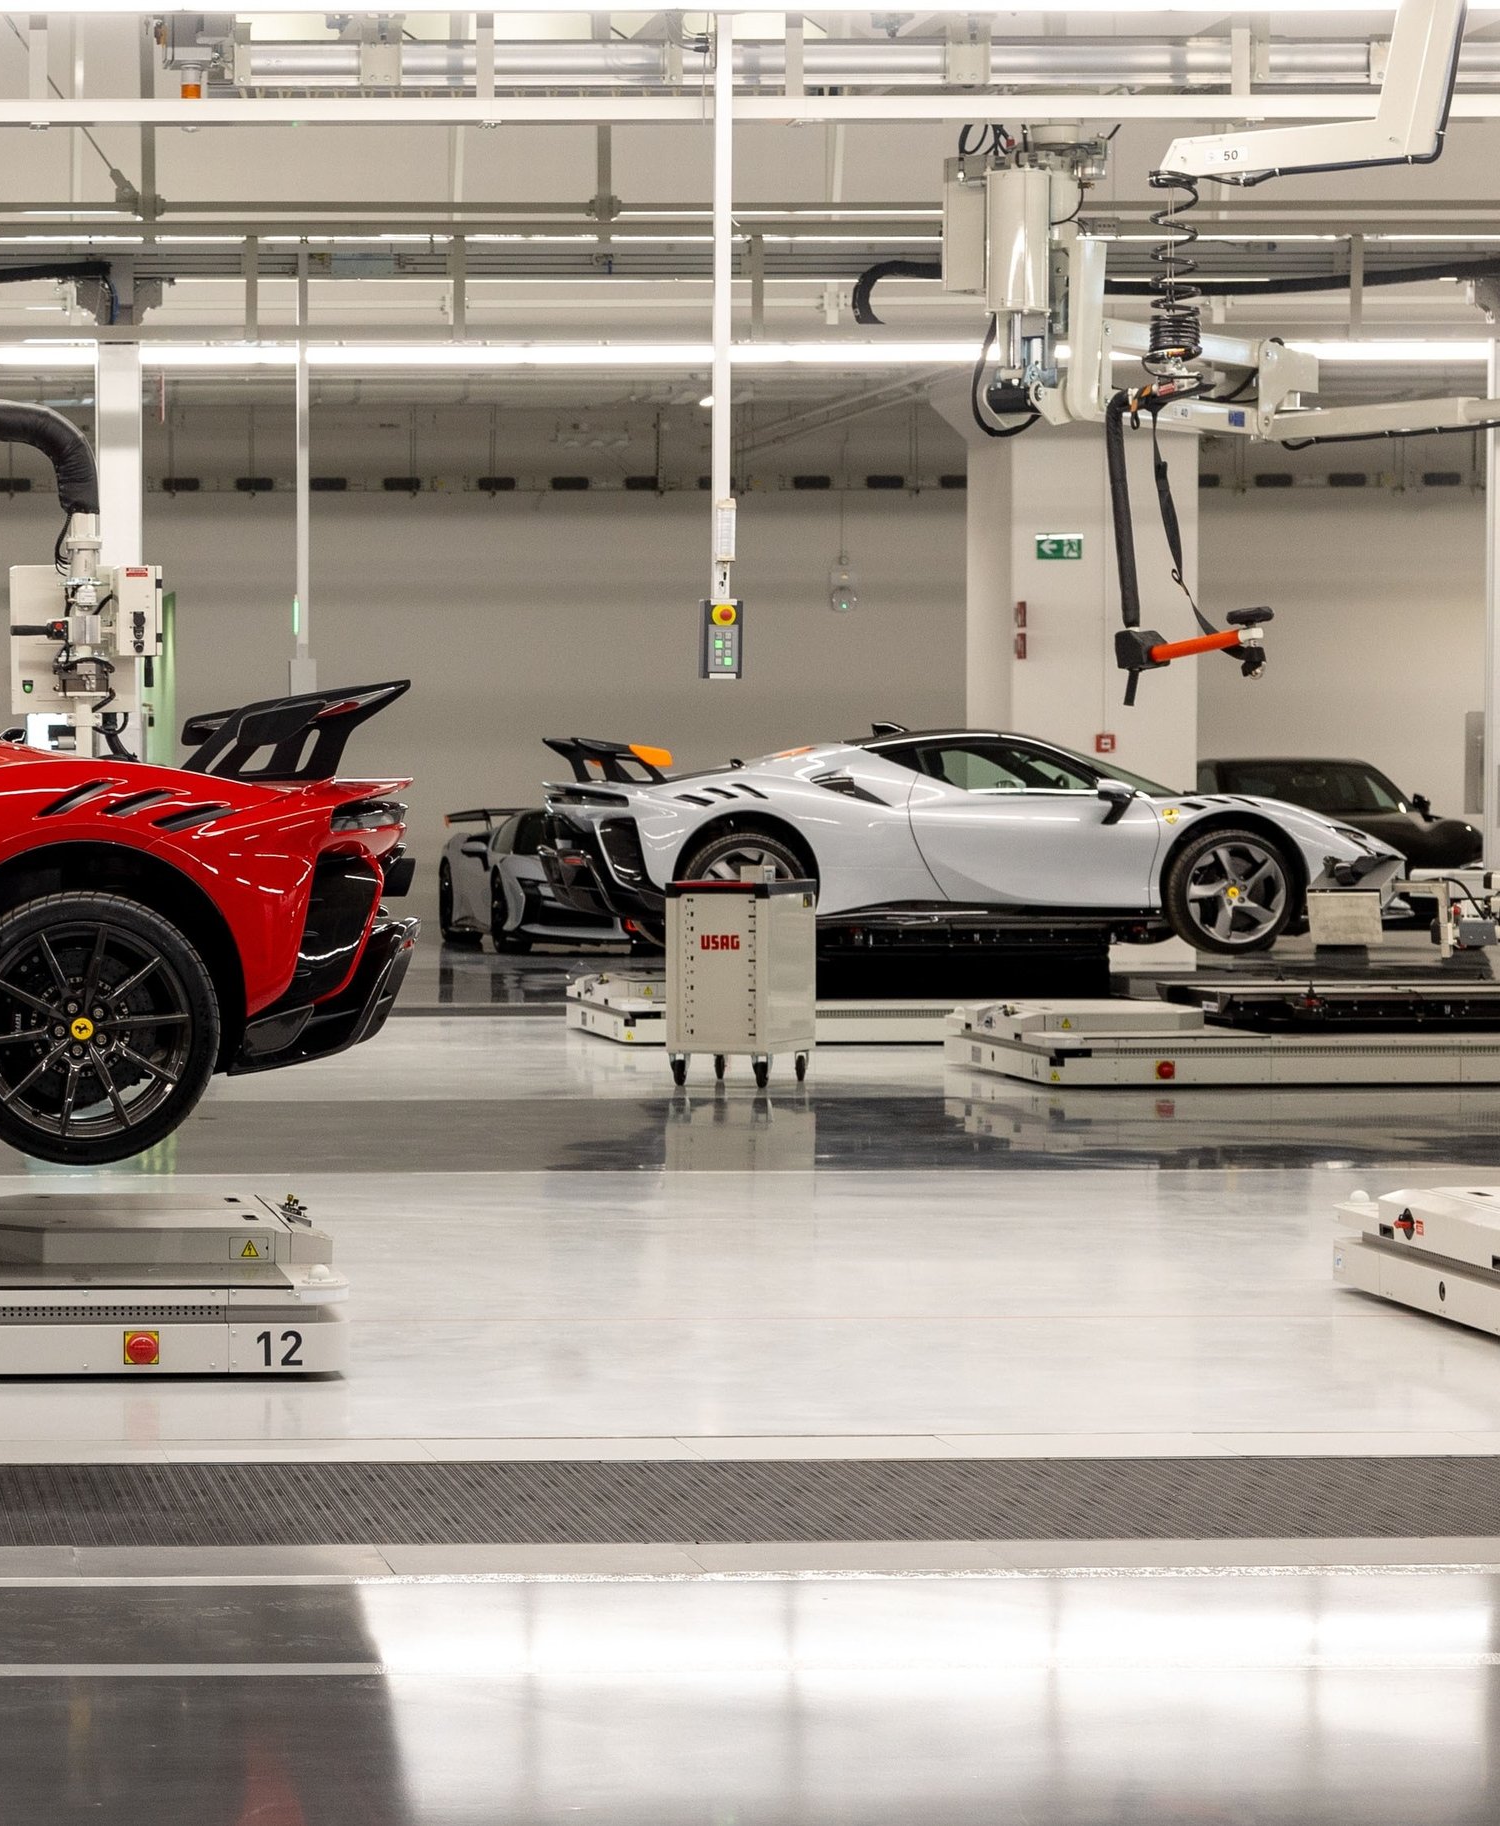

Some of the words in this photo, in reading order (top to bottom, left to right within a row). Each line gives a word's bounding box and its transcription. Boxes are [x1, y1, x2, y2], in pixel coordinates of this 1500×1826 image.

[1223, 150, 1239, 161] 50
[700, 935, 740, 950] USAG
[256, 1330, 303, 1367] 12
